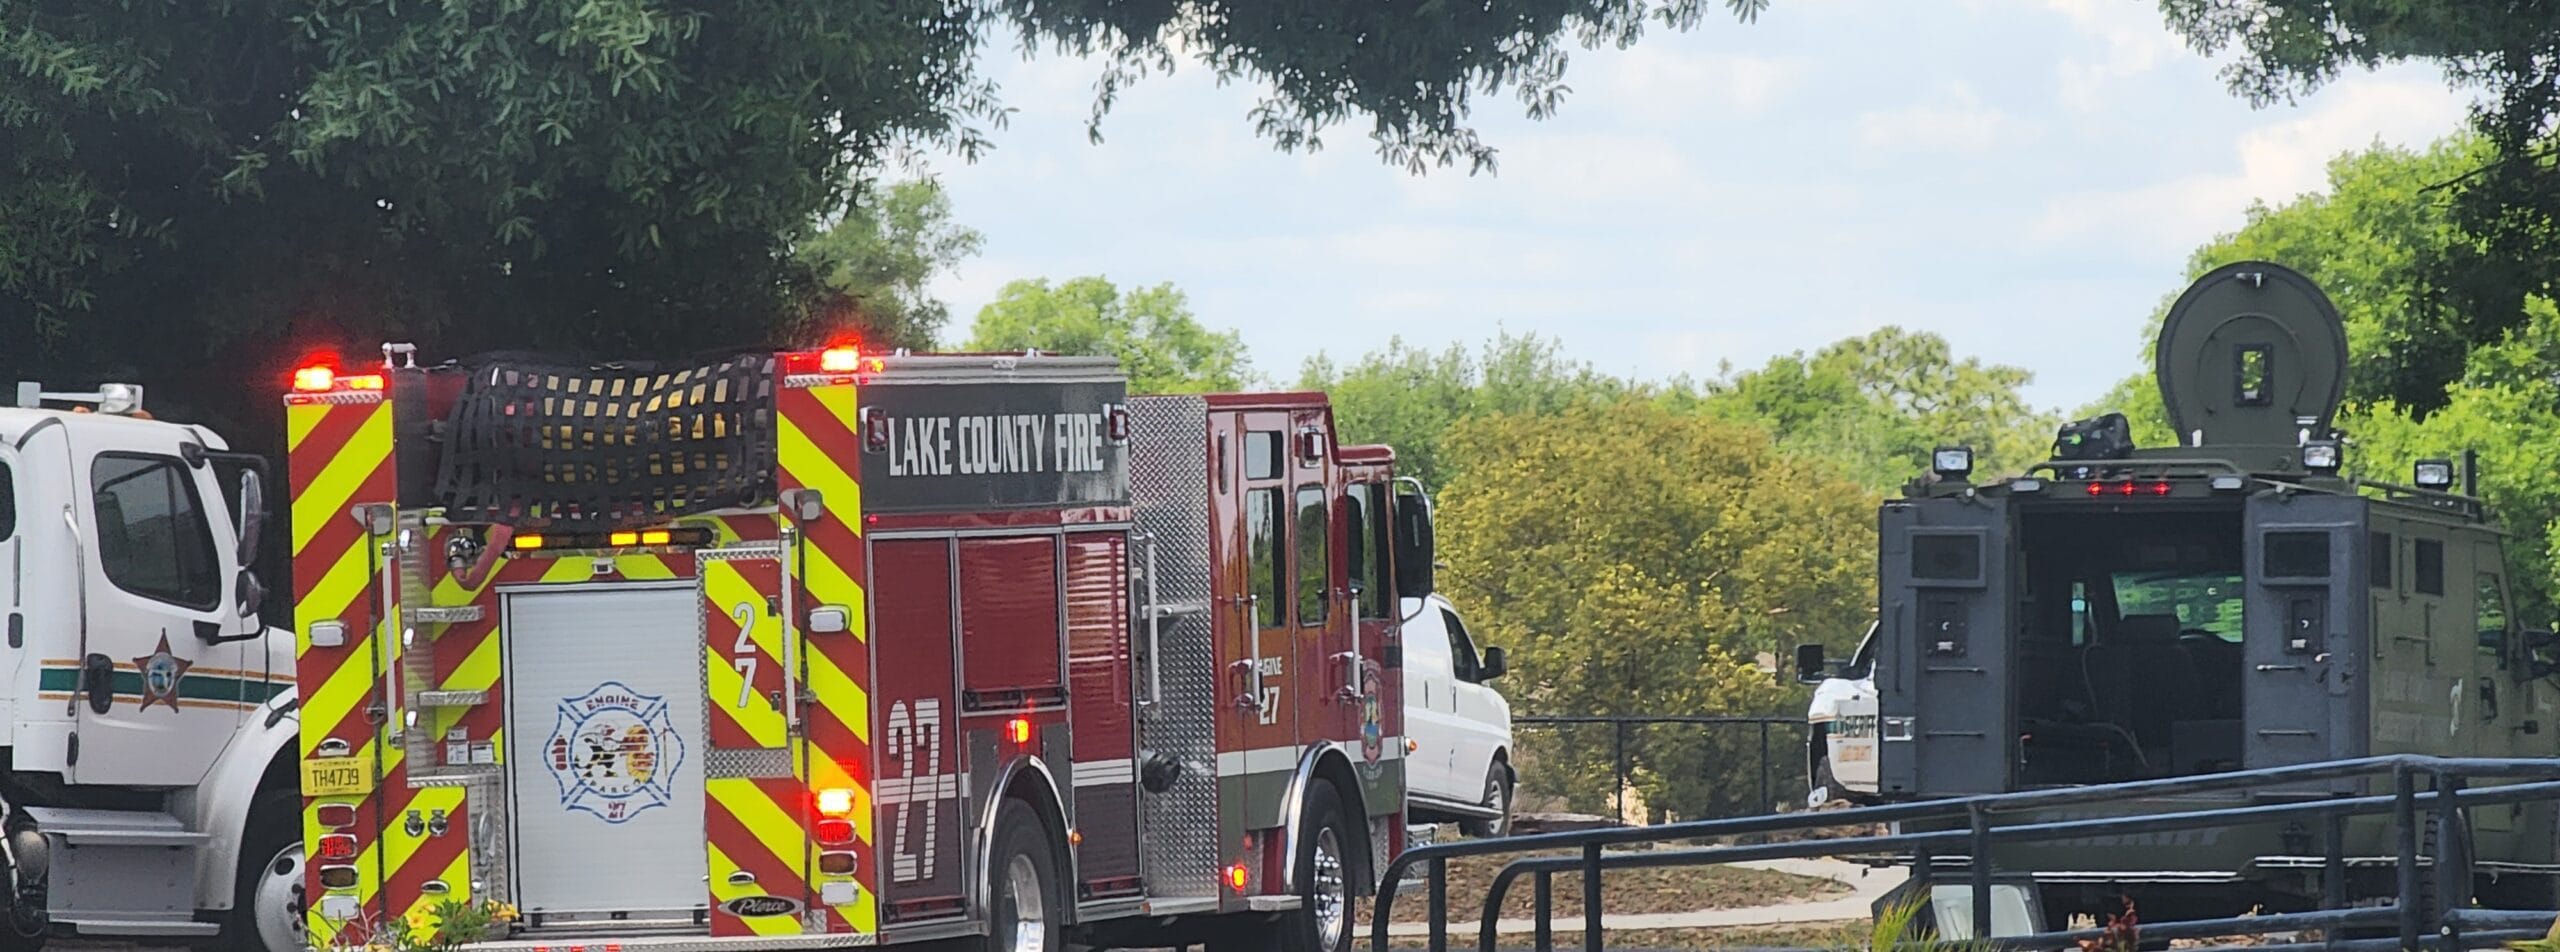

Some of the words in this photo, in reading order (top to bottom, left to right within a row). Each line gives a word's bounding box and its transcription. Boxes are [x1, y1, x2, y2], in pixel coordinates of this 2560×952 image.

[887, 416, 952, 477] LAKE
[958, 414, 1046, 475] COUNTY
[1054, 413, 1104, 473] FIRE
[1262, 656, 1283, 676] GINE
[585, 695, 641, 711] ENGINE
[1260, 686, 1280, 725] 27
[312, 768, 359, 787] TH4739
[887, 698, 940, 882] 27
[608, 801, 627, 818] 27
[737, 899, 787, 914] Pierce
